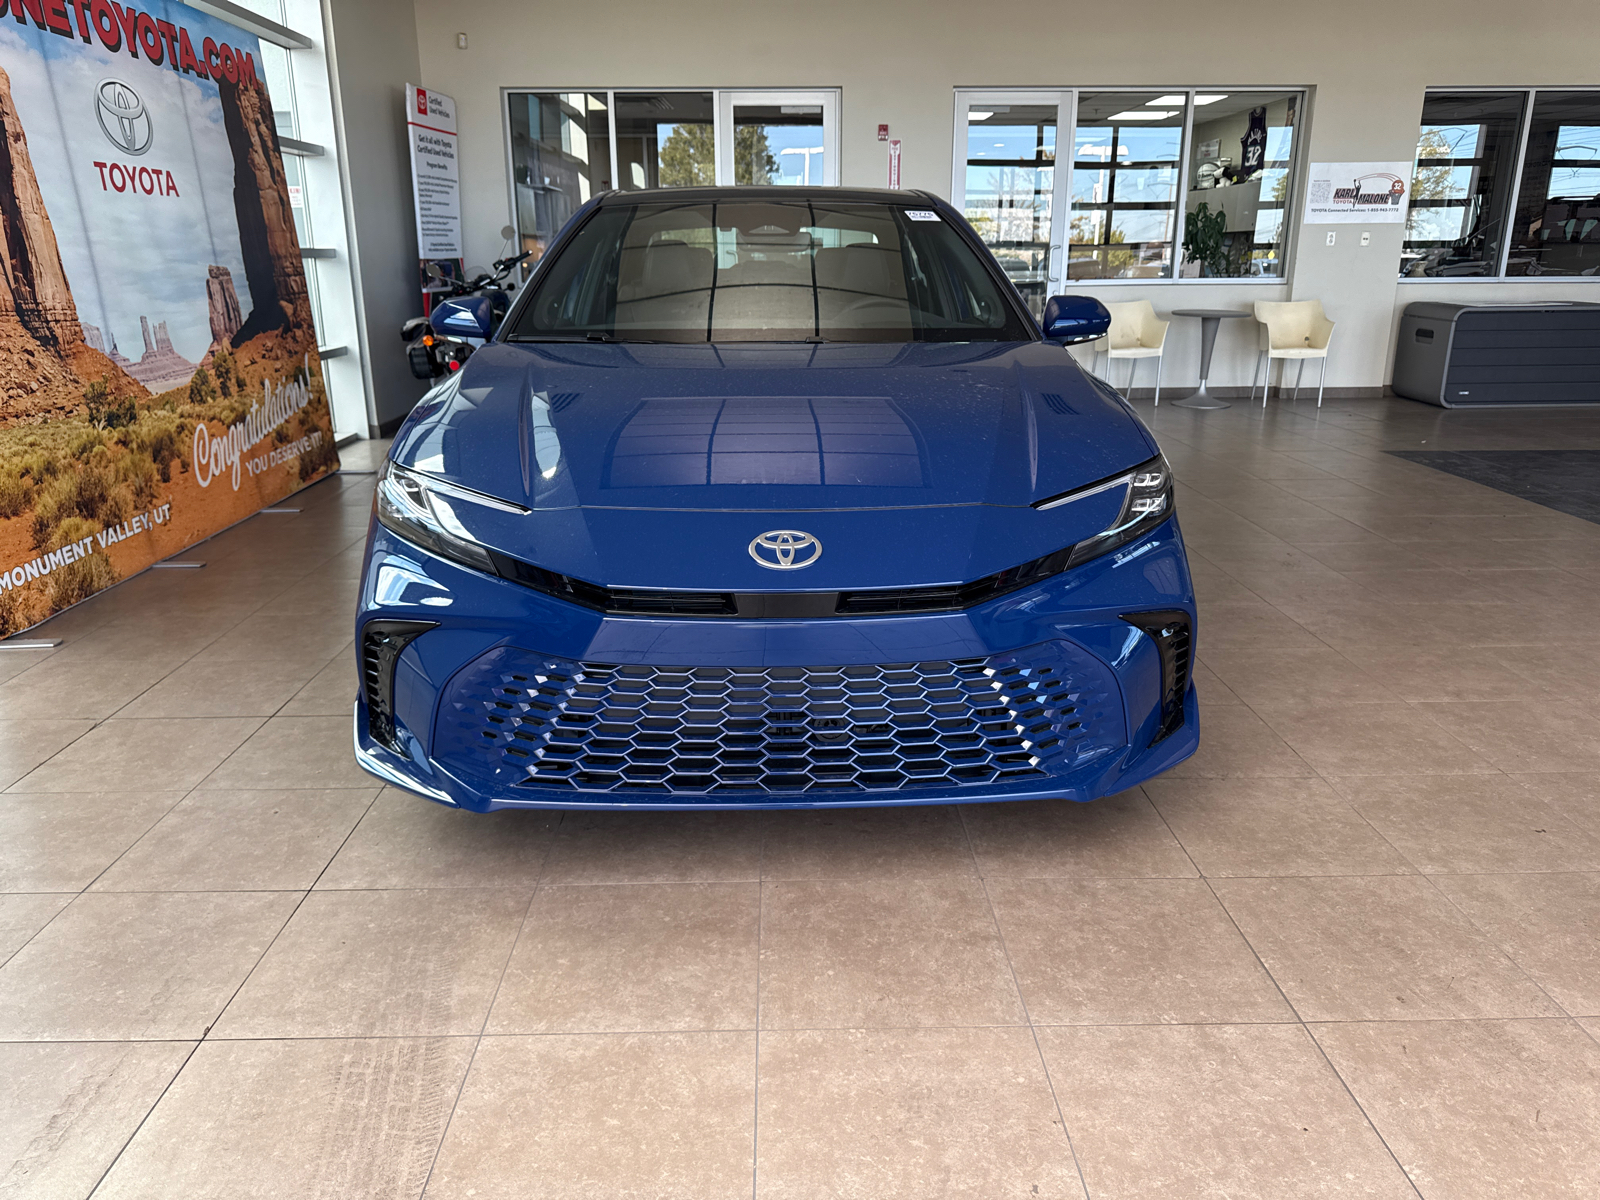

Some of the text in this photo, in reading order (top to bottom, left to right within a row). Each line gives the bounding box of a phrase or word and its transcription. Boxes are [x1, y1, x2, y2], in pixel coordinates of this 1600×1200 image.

[0, 0, 259, 90] ETOYOTA.COM
[1244, 145, 1262, 166] 32
[93, 161, 180, 198] TOYOTA
[1333, 188, 1356, 199] KARL
[1393, 182, 1402, 190] 32
[1357, 193, 1391, 205] MALONE
[193, 352, 314, 492] Congratulations!
[245, 431, 323, 477] YOU DESERVE IT!
[0, 503, 171, 595] MONUMENT VALLEY, UT
